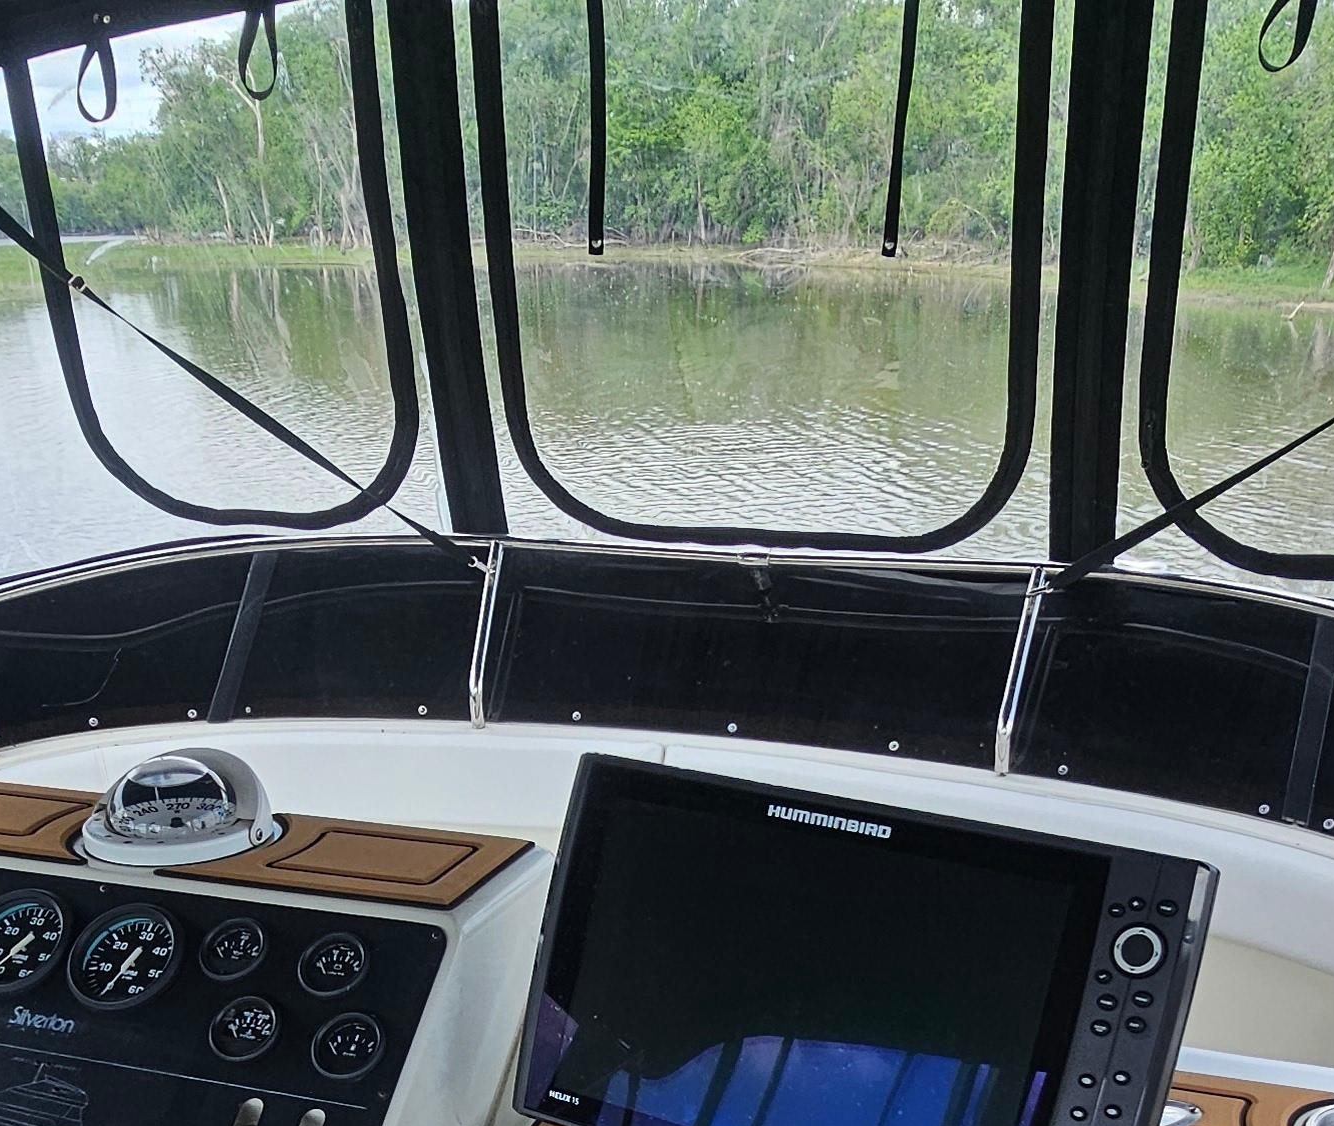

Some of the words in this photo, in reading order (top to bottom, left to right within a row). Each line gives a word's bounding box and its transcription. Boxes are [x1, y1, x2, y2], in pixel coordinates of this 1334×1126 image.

[133, 806, 158, 817] 240
[767, 804, 892, 839] HUMMINBIRD
[29, 917, 45, 926] 30
[4, 926, 20, 936] 20
[42, 931, 58, 941] 40
[138, 931, 155, 941] 30
[112, 941, 129, 951] 20
[152, 947, 168, 956] 40
[99, 962, 113, 972] 10
[8, 1005, 75, 1034] Silverton
[549, 1089, 571, 1102] HELIX
[572, 1096, 580, 1106] 15
